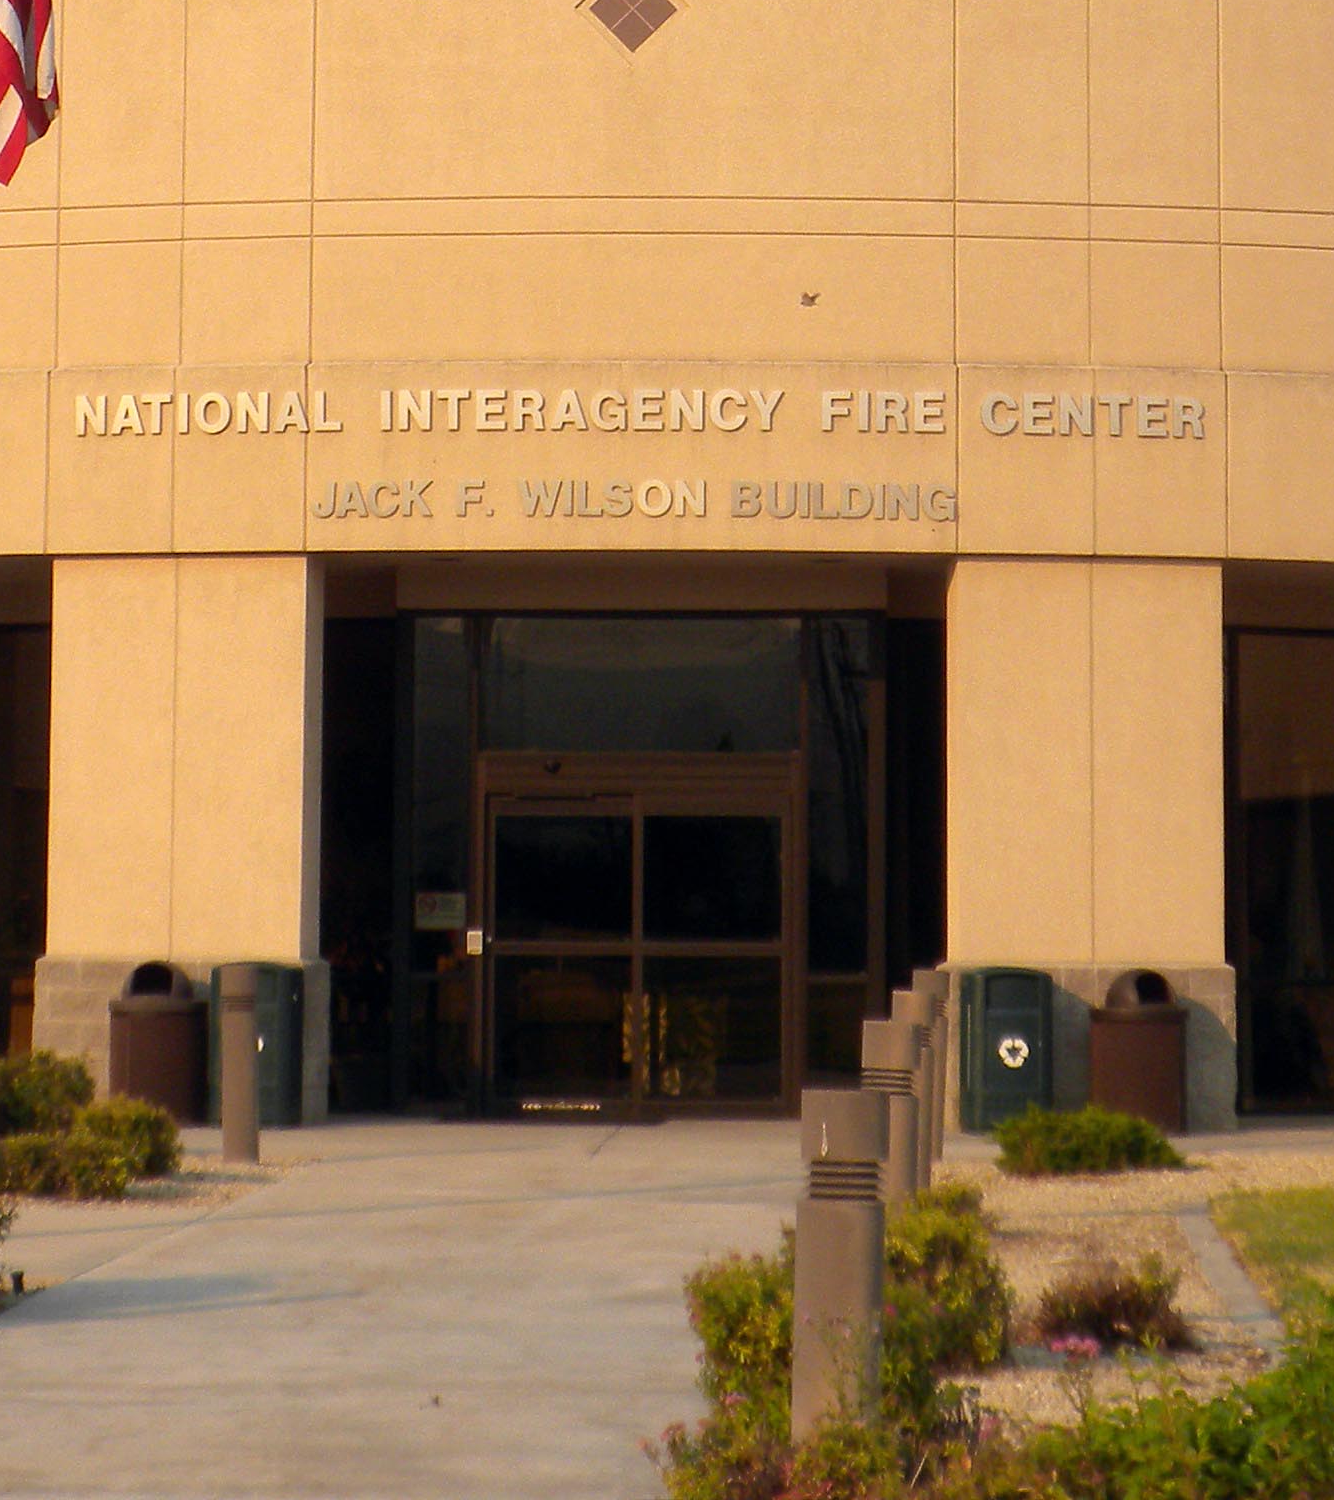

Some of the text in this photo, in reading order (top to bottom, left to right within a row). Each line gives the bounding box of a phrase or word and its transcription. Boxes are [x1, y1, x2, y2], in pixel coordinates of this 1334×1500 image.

[75, 388, 1206, 439] NATIONAL INTERAGENCY FIRE CENTER
[312, 479, 957, 522] JACK F. WILSON BUILDING
